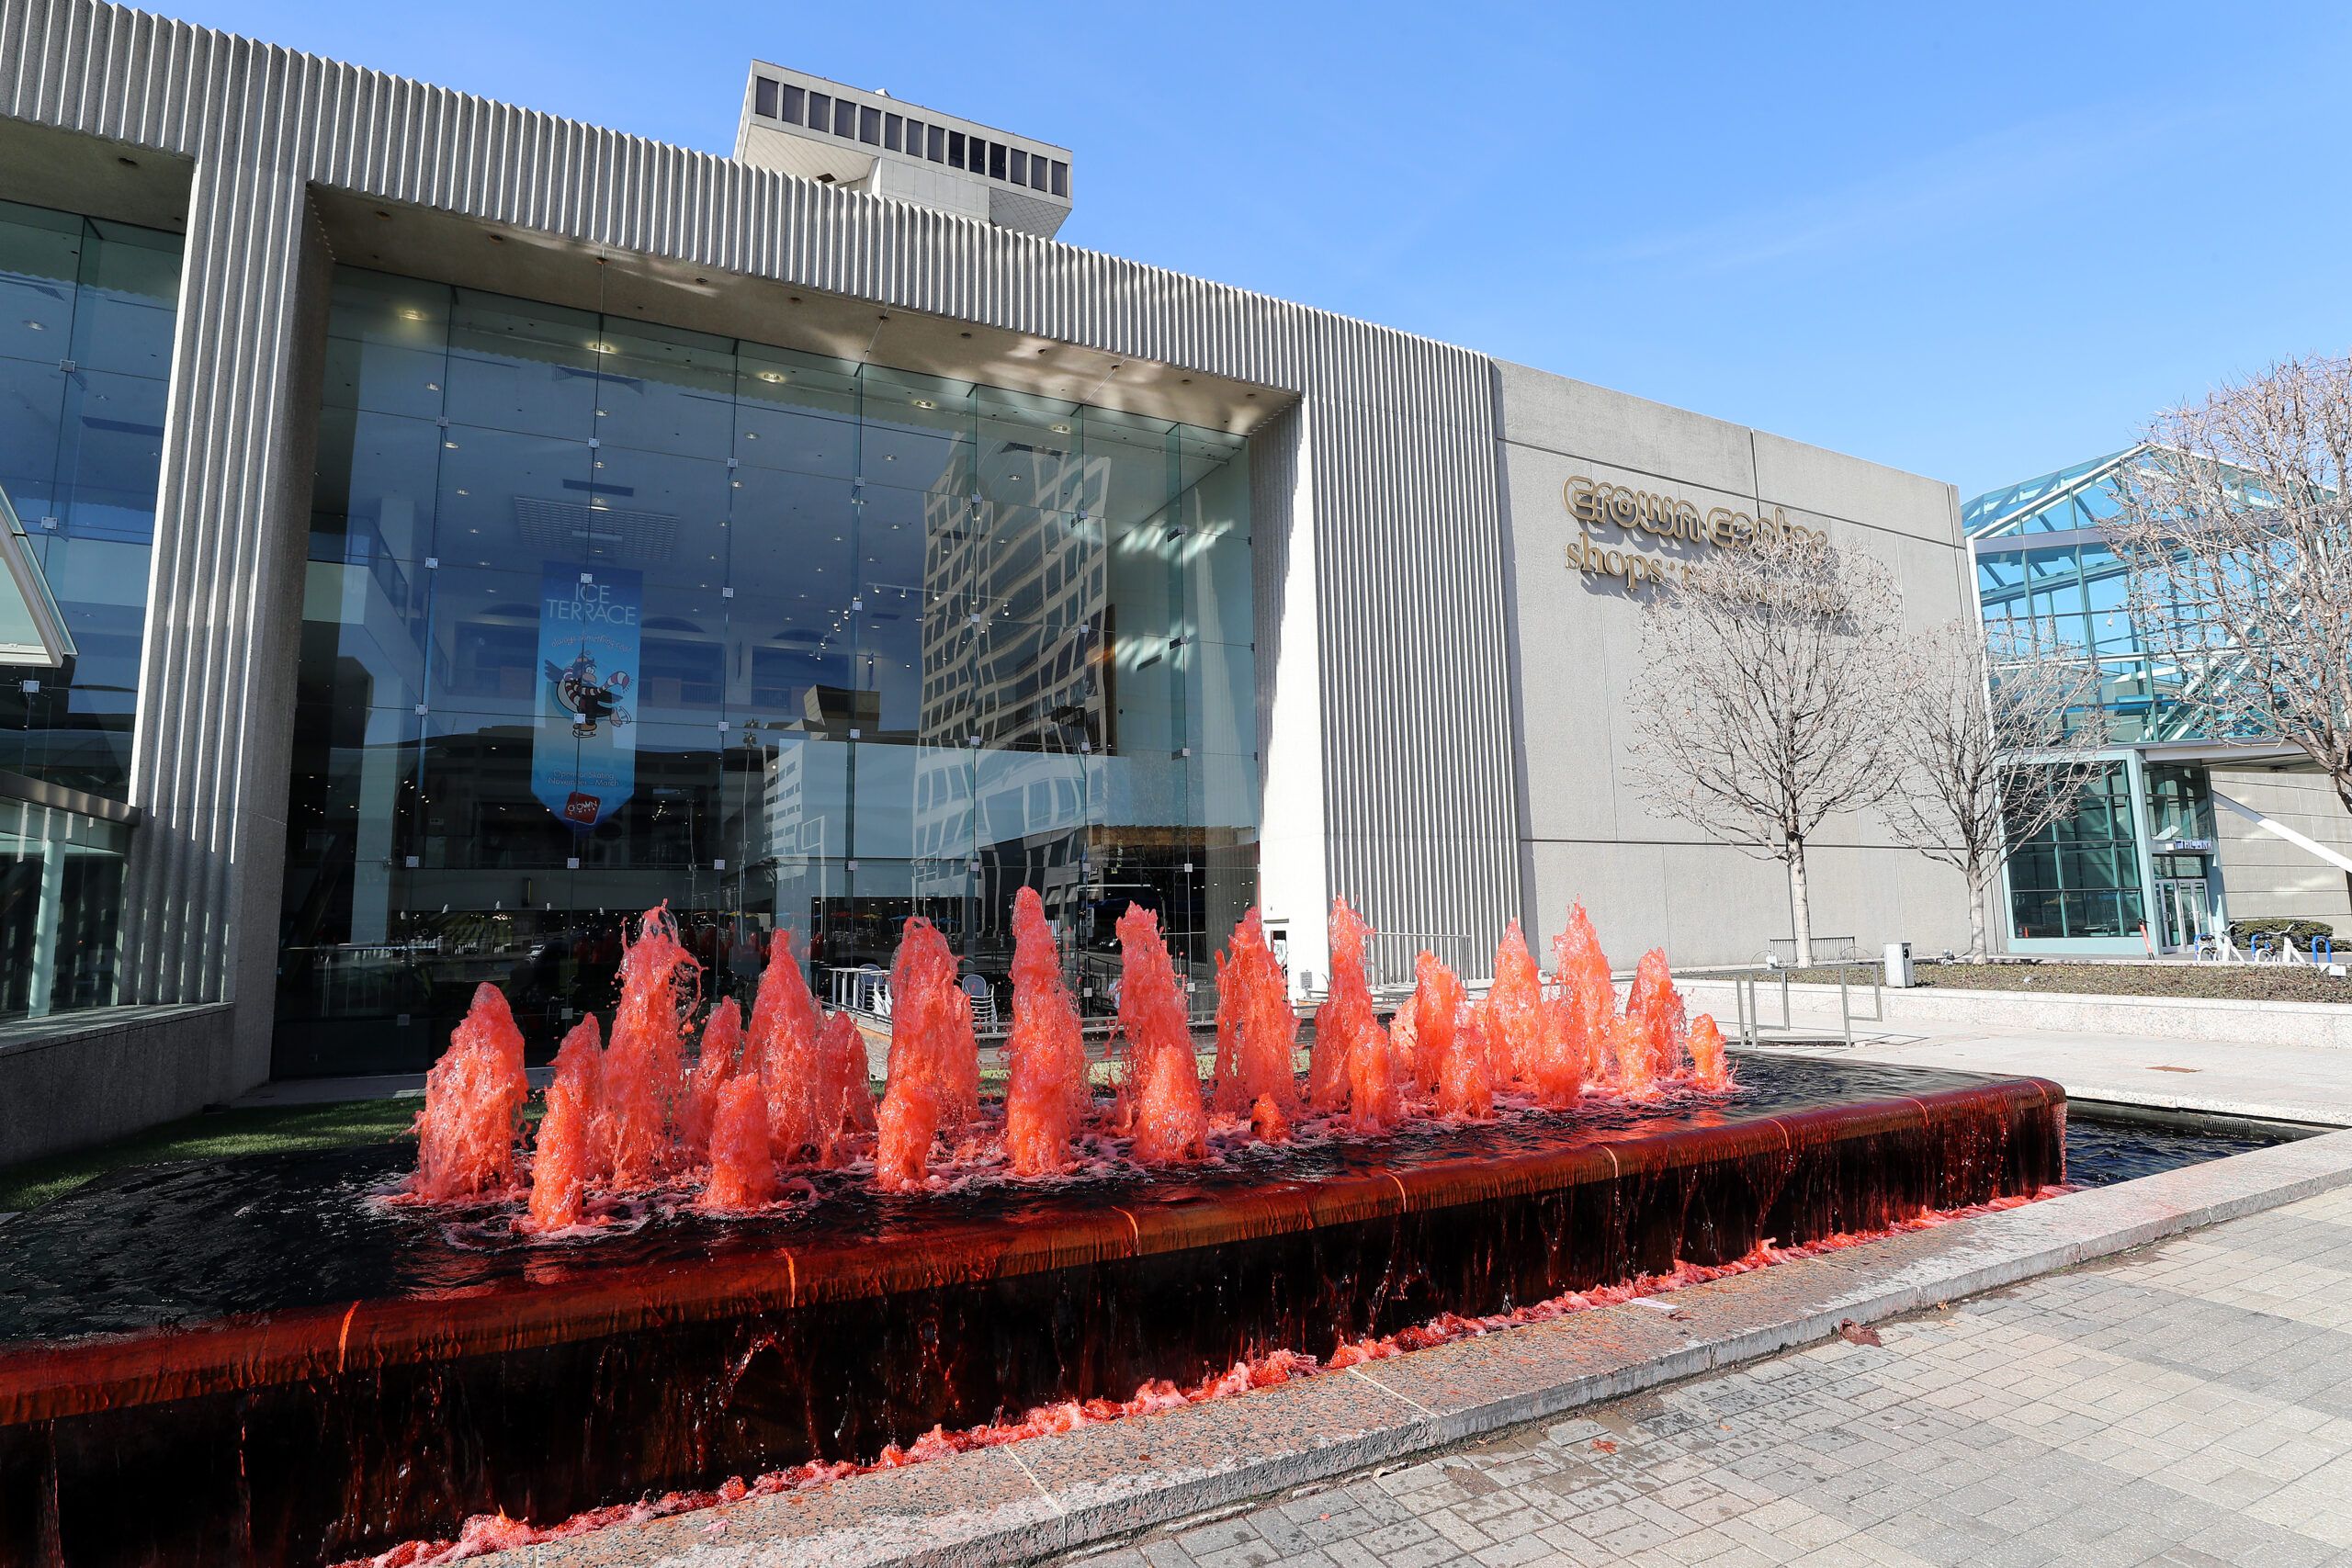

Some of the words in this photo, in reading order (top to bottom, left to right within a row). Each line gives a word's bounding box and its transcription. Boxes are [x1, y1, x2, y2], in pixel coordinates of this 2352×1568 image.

[1563, 475, 1702, 543] crown
[1565, 531, 1666, 592] shops
[575, 582, 611, 604] ICE
[546, 598, 637, 626] TERRACE
[554, 770, 575, 778] Open
[589, 772, 615, 780] Skating
[595, 779, 619, 787] March
